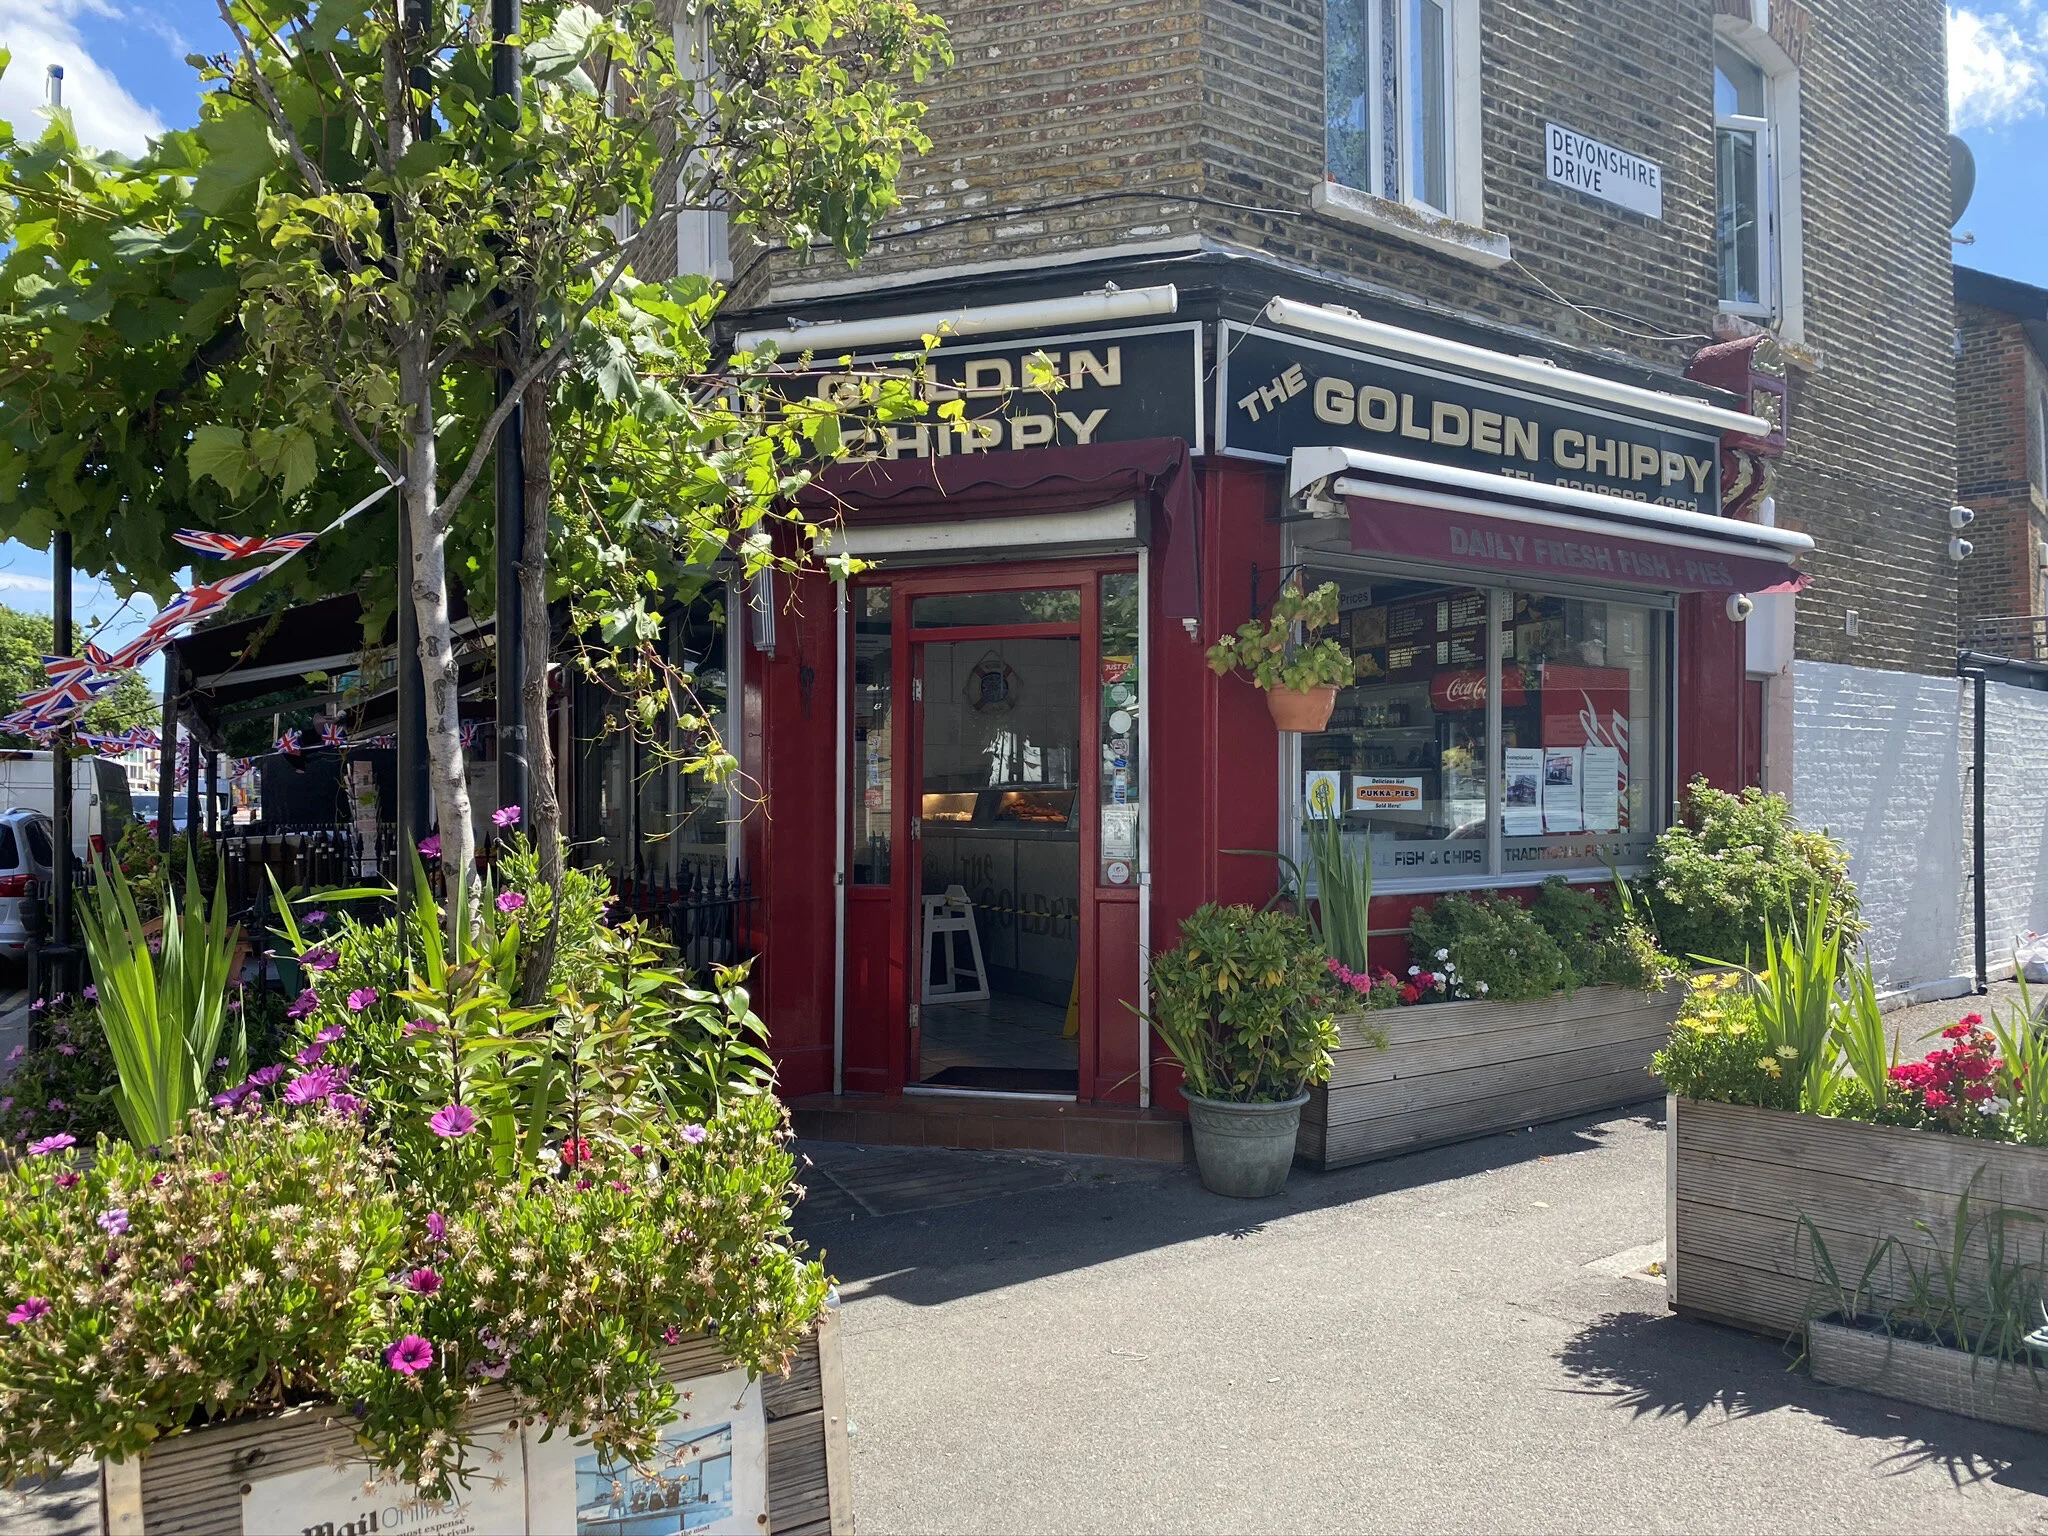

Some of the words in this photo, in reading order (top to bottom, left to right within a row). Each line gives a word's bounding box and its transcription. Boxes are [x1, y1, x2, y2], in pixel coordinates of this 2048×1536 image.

[1553, 129, 1656, 188] DEVONSHIRE
[1553, 155, 1602, 192] DRIVE
[817, 346, 1121, 406] GOLDEN
[836, 409, 1109, 464] CHIPPY
[1237, 363, 1307, 422] THE
[1313, 376, 1538, 461] GOLDEN
[1553, 428, 1712, 494] CHIPPY
[1450, 526, 1525, 561] DAILY
[1533, 538, 1615, 572] FRESH
[1617, 550, 1671, 579] FISH
[1684, 559, 1734, 586] PIES
[1105, 663, 1122, 671] JUST
[1394, 851, 1425, 866] FISH
[1443, 849, 1482, 864] CHIPS
[424, 1518, 465, 1533] expense
